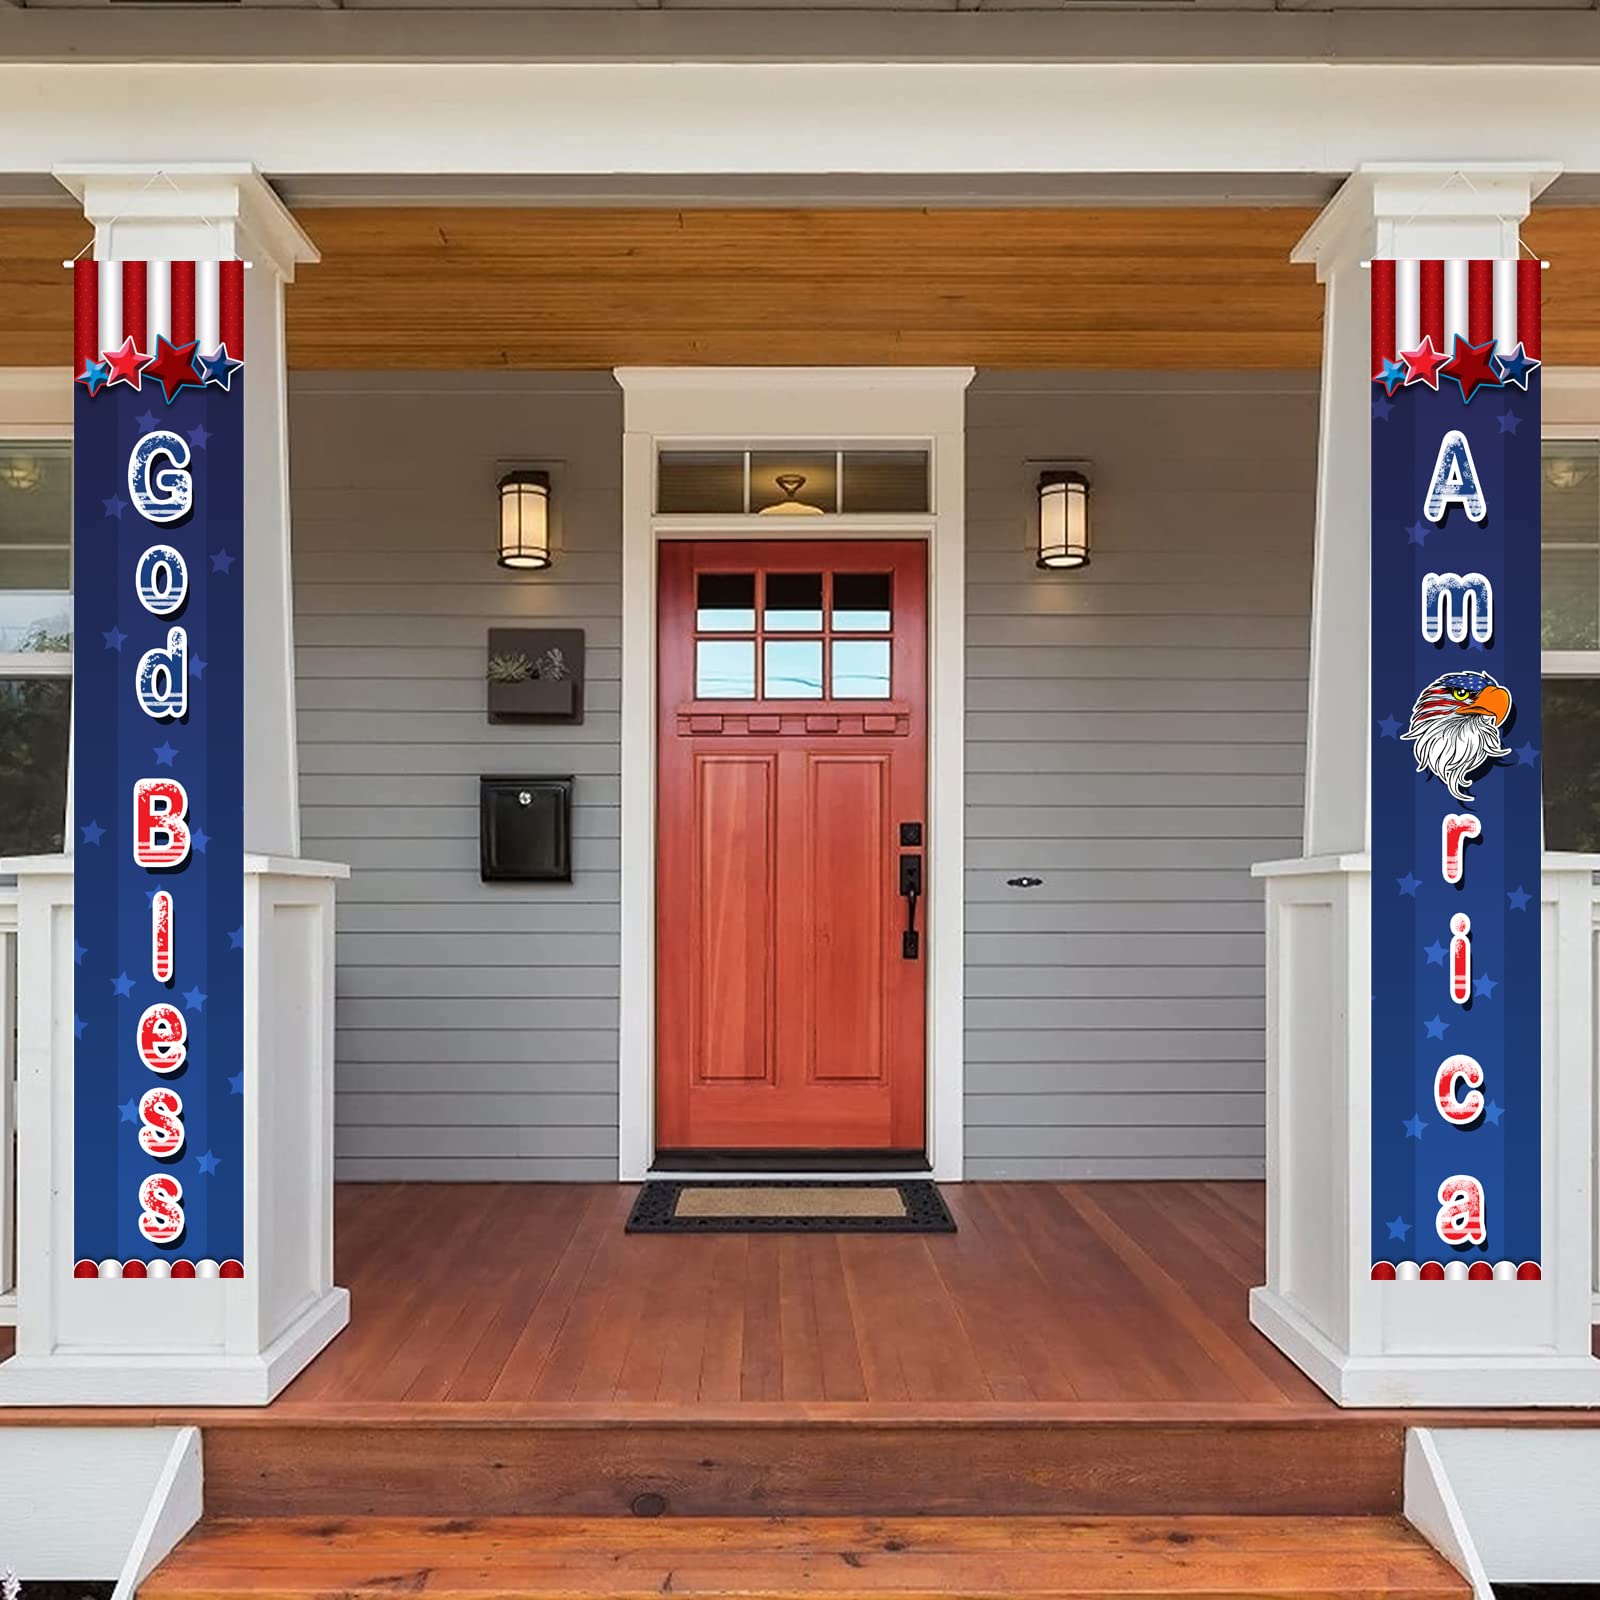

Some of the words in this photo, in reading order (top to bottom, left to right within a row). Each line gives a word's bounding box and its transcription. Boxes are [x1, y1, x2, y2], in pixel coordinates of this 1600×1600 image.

[127, 430, 193, 719] God
[133, 777, 191, 1244] Bless
[1420, 429, 1494, 1245] Amrica
